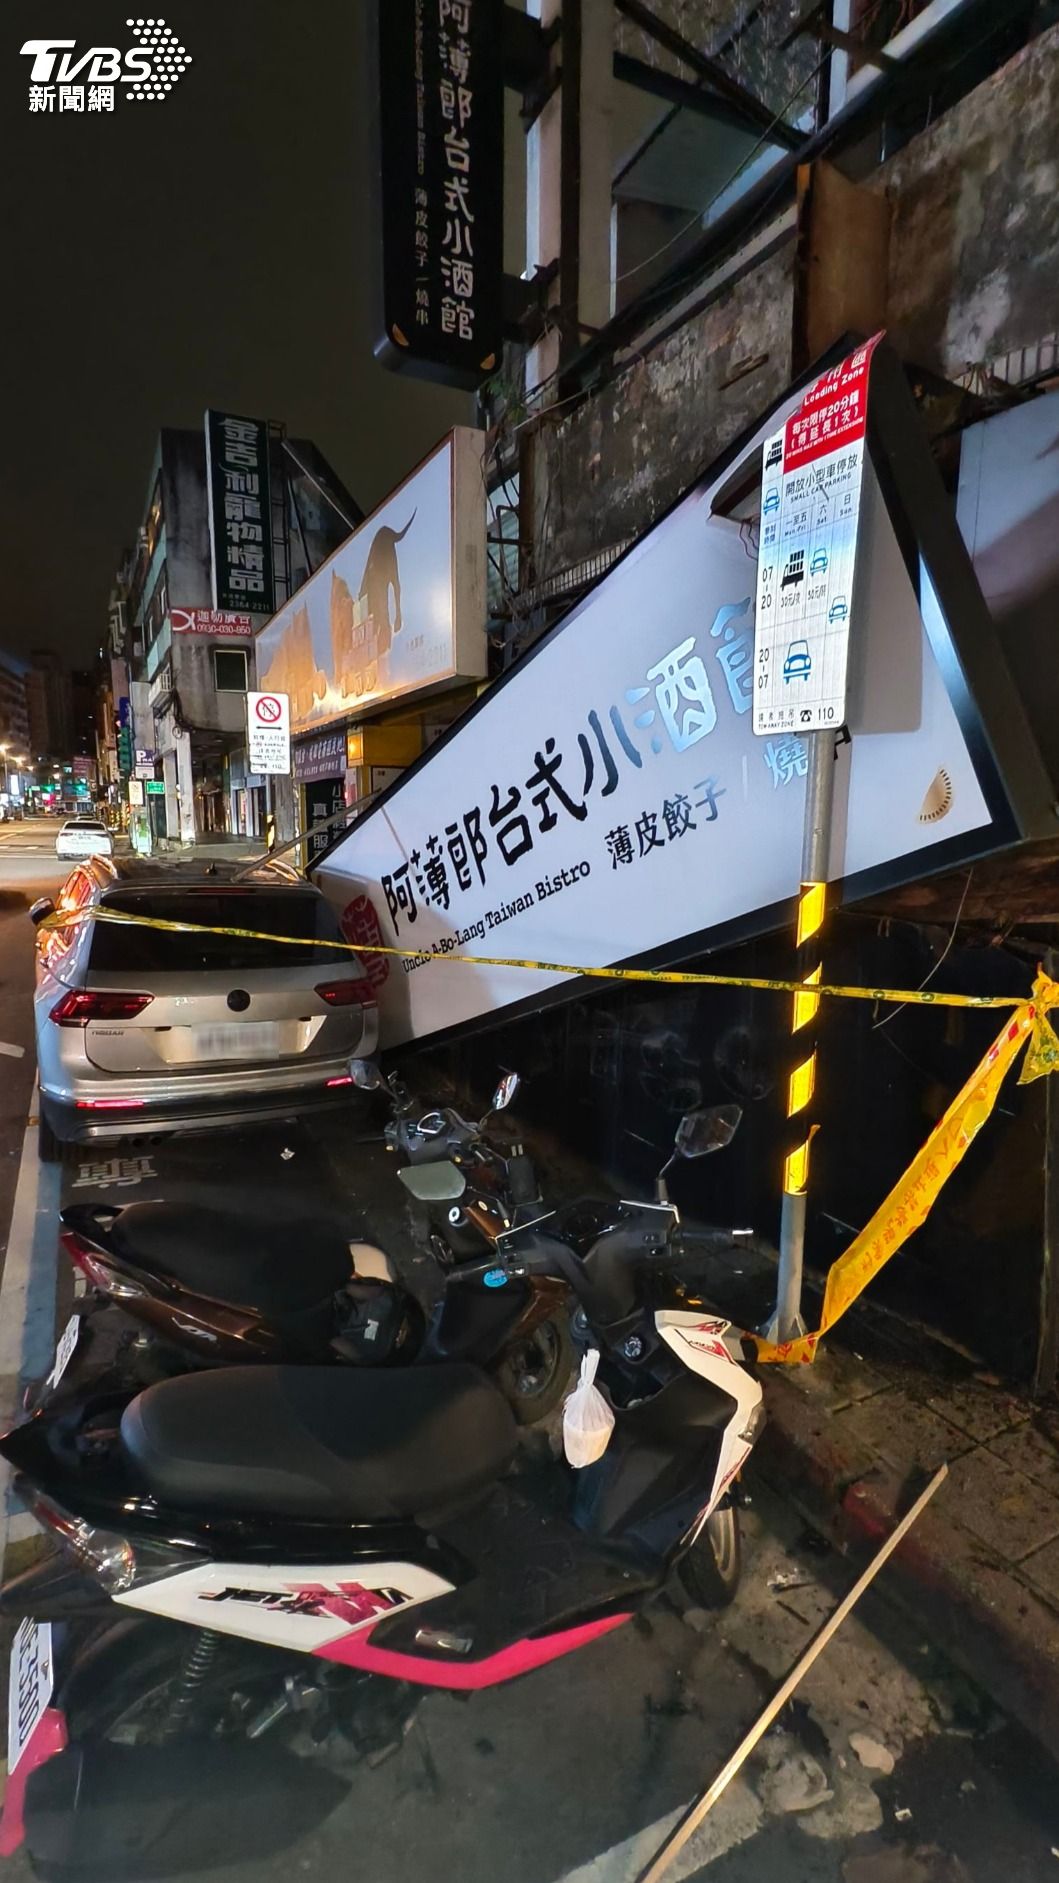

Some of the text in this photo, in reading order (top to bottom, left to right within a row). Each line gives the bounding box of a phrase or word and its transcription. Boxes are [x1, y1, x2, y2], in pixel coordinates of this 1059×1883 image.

[804, 366, 865, 407] Loading Zone
[792, 389, 860, 435] 每次限停20分鐘
[785, 453, 858, 497] 開放小型車停放
[790, 489, 810, 503] SMALL
[824, 474, 852, 491] PARKING
[843, 494, 851, 505] 日
[819, 504, 827, 514] 六
[786, 511, 807, 526] 一至五
[762, 566, 773, 582] 07
[761, 594, 772, 610] 20
[759, 648, 769, 663] 20
[758, 674, 769, 689] 07
[818, 707, 834, 720] 110
[603, 774, 727, 871] 薄皮餃子
[432, 919, 486, 957] A-Bo-Lang
[485, 892, 535, 930] Taiwan
[535, 860, 592, 902] Bistro
